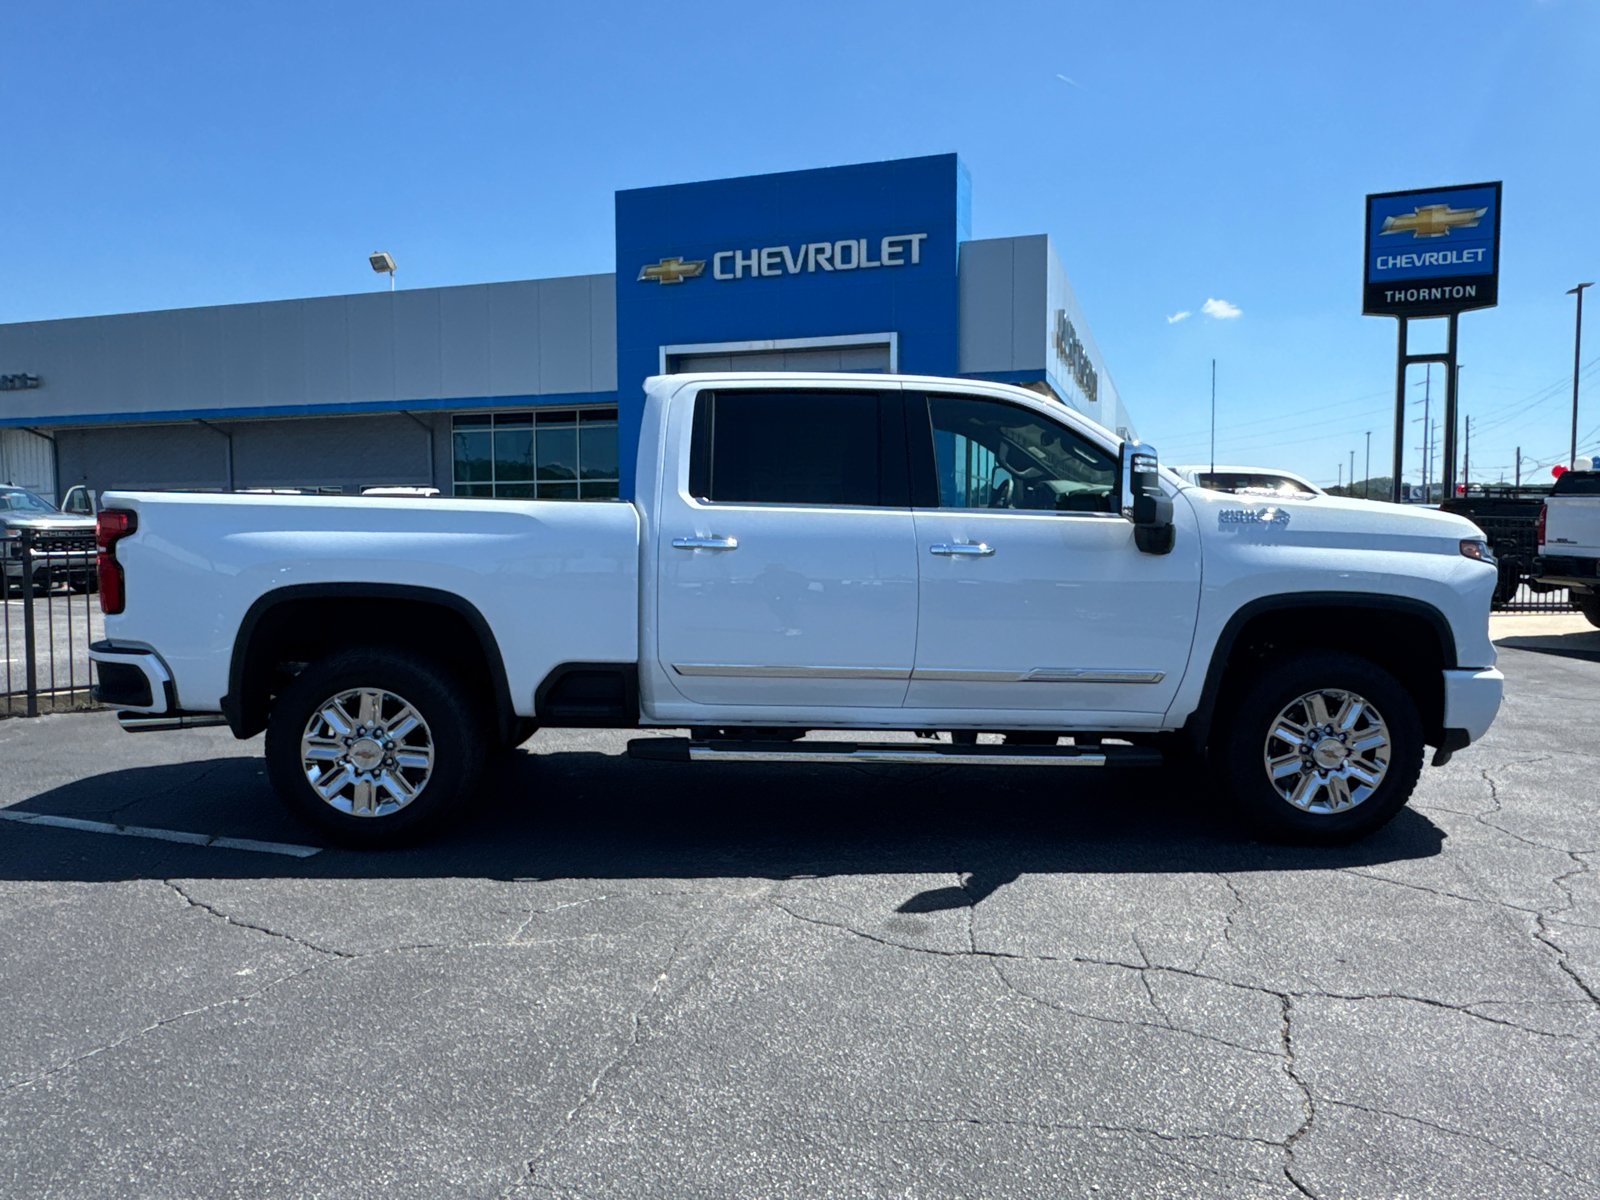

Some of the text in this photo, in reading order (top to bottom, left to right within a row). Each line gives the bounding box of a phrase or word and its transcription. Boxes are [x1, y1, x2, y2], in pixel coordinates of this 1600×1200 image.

[713, 233, 928, 280] CHEVROLET
[1376, 248, 1486, 269] CHEVROLET
[1384, 285, 1476, 302] THORNTON
